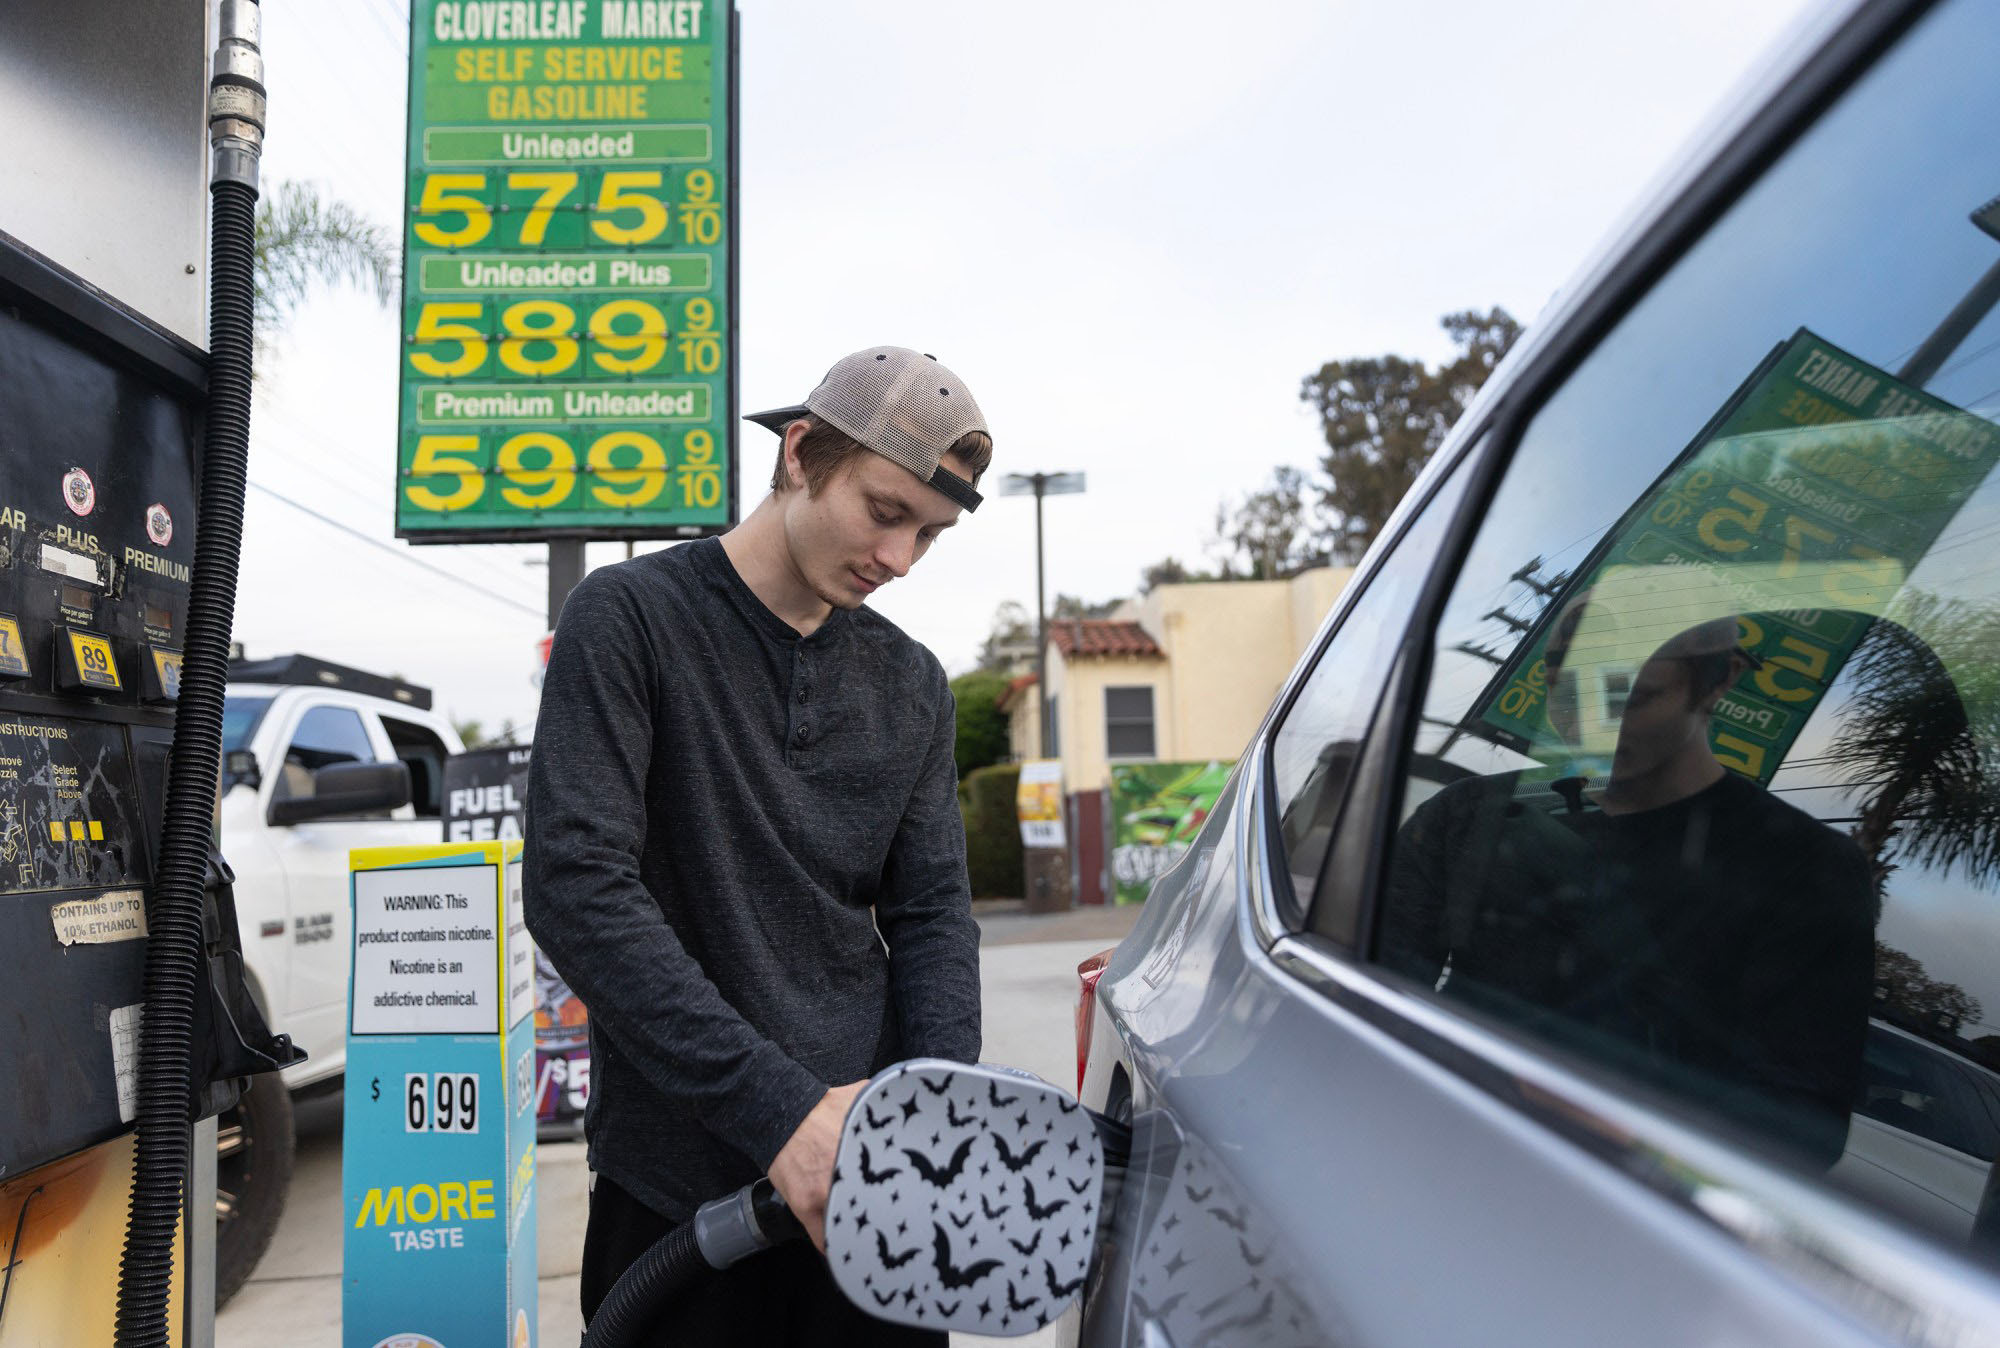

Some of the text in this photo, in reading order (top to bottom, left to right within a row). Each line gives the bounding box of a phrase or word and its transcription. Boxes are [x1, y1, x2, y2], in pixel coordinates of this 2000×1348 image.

[435, 0, 702, 40] CLOVERLEAF MARKET
[455, 46, 683, 82] SELF SERVICE
[488, 85, 648, 120] GASOLINE
[503, 131, 634, 158] Unleaded
[461, 260, 671, 286] Unleaded Plus
[435, 390, 694, 417] Premium Unleaded
[0, 506, 26, 532] AR
[57, 523, 98, 555] PLUS
[125, 547, 189, 583] PREMIUM
[82, 645, 107, 671] 89
[52, 764, 77, 775] Select
[55, 777, 79, 787] Grade
[57, 789, 82, 799] Above
[450, 784, 521, 816] FUEL
[52, 900, 140, 919] CONTAINS UP TO
[384, 893, 468, 911] WARNING: This
[64, 918, 138, 938] 10% ETHANOL
[359, 928, 399, 947] product
[401, 926, 446, 942] contains
[449, 925, 495, 941] nicotine.
[389, 958, 463, 974] Nicotine is an
[374, 990, 478, 1007] addictive chemical.
[371, 1077, 380, 1102] $
[408, 1076, 477, 1130] 6.99
[354, 1179, 496, 1228] MORE
[389, 1227, 464, 1251] TASTE
